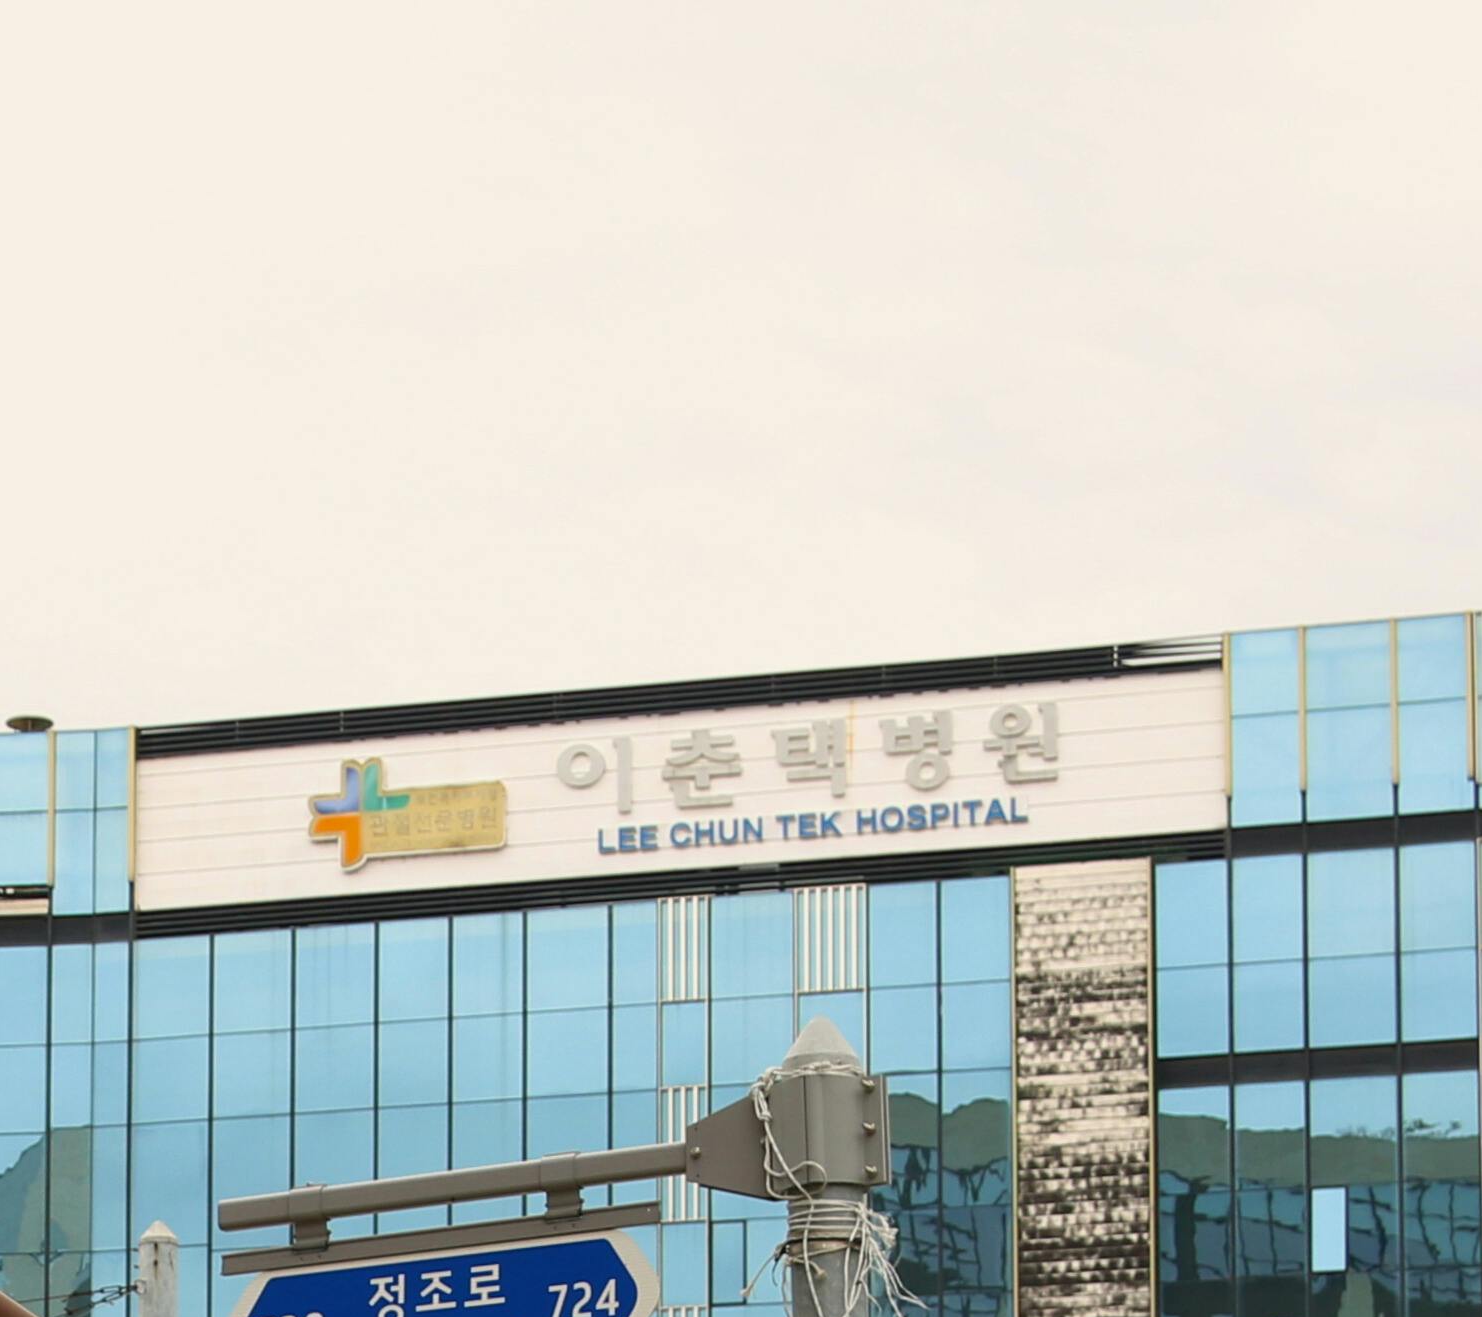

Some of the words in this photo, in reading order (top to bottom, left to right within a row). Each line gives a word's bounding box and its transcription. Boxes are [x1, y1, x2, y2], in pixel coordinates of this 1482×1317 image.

[555, 702, 1061, 813] 이춘택병원
[598, 825, 659, 855] LEE
[670, 816, 765, 850] CHUN
[776, 811, 843, 842] TEK
[856, 796, 1030, 833] HOSPITAL
